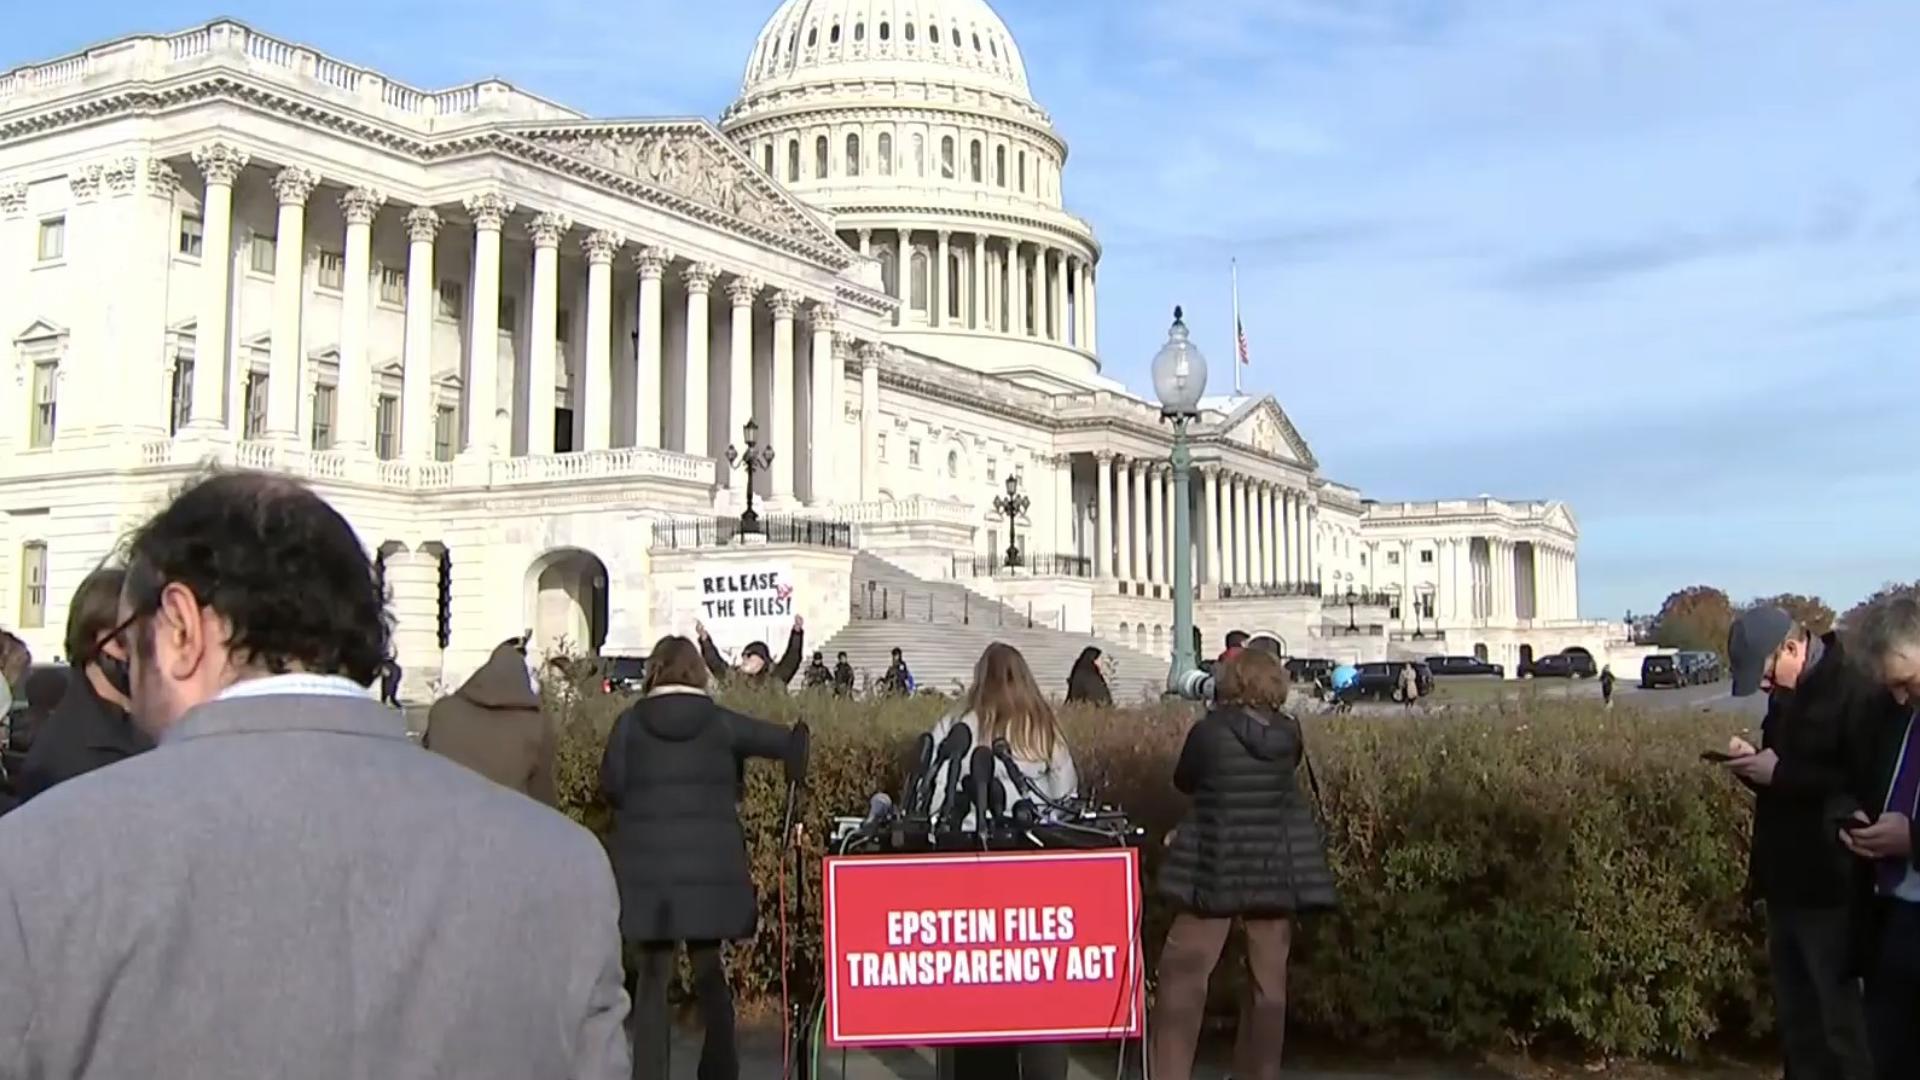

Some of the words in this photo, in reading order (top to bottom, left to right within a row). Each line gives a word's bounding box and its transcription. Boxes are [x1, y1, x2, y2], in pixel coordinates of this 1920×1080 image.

[703, 572, 778, 594] RELEASE
[702, 599, 735, 619] THE
[743, 596, 792, 617] FILES!
[887, 908, 996, 945] EPSTEIN
[1003, 905, 1074, 942] FILES
[846, 946, 1058, 987] TRANSPARENCY
[1065, 945, 1117, 980] ACT
